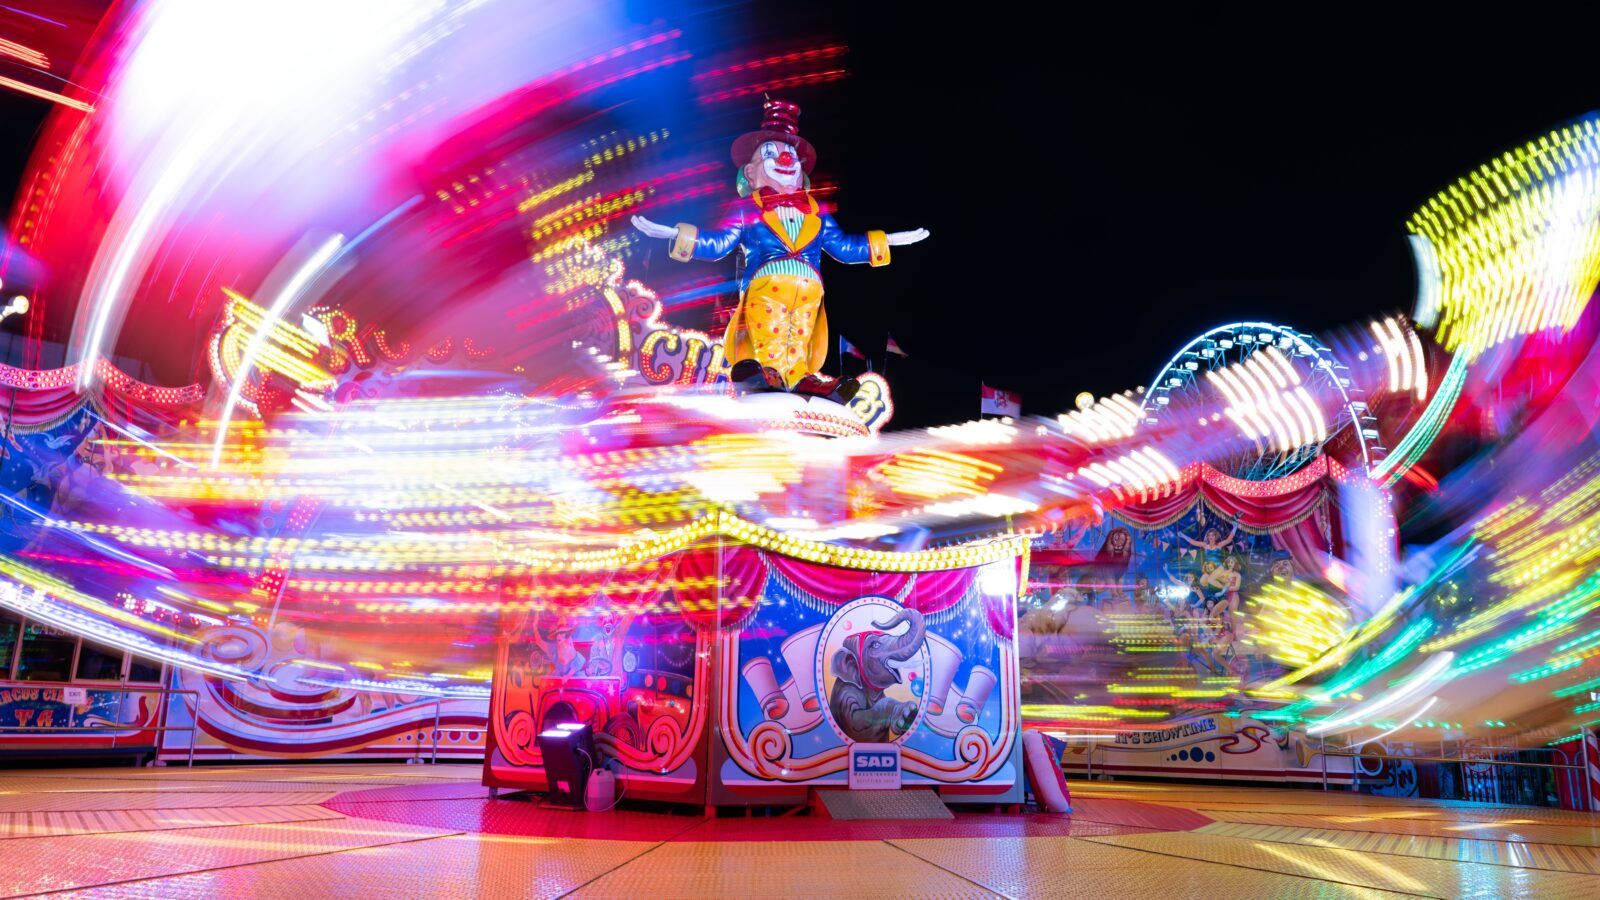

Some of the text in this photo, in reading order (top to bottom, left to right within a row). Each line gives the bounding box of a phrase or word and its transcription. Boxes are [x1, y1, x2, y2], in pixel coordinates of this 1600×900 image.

[1115, 718, 1216, 744] IT'S SHOWTIME
[856, 756, 895, 768] SAD
